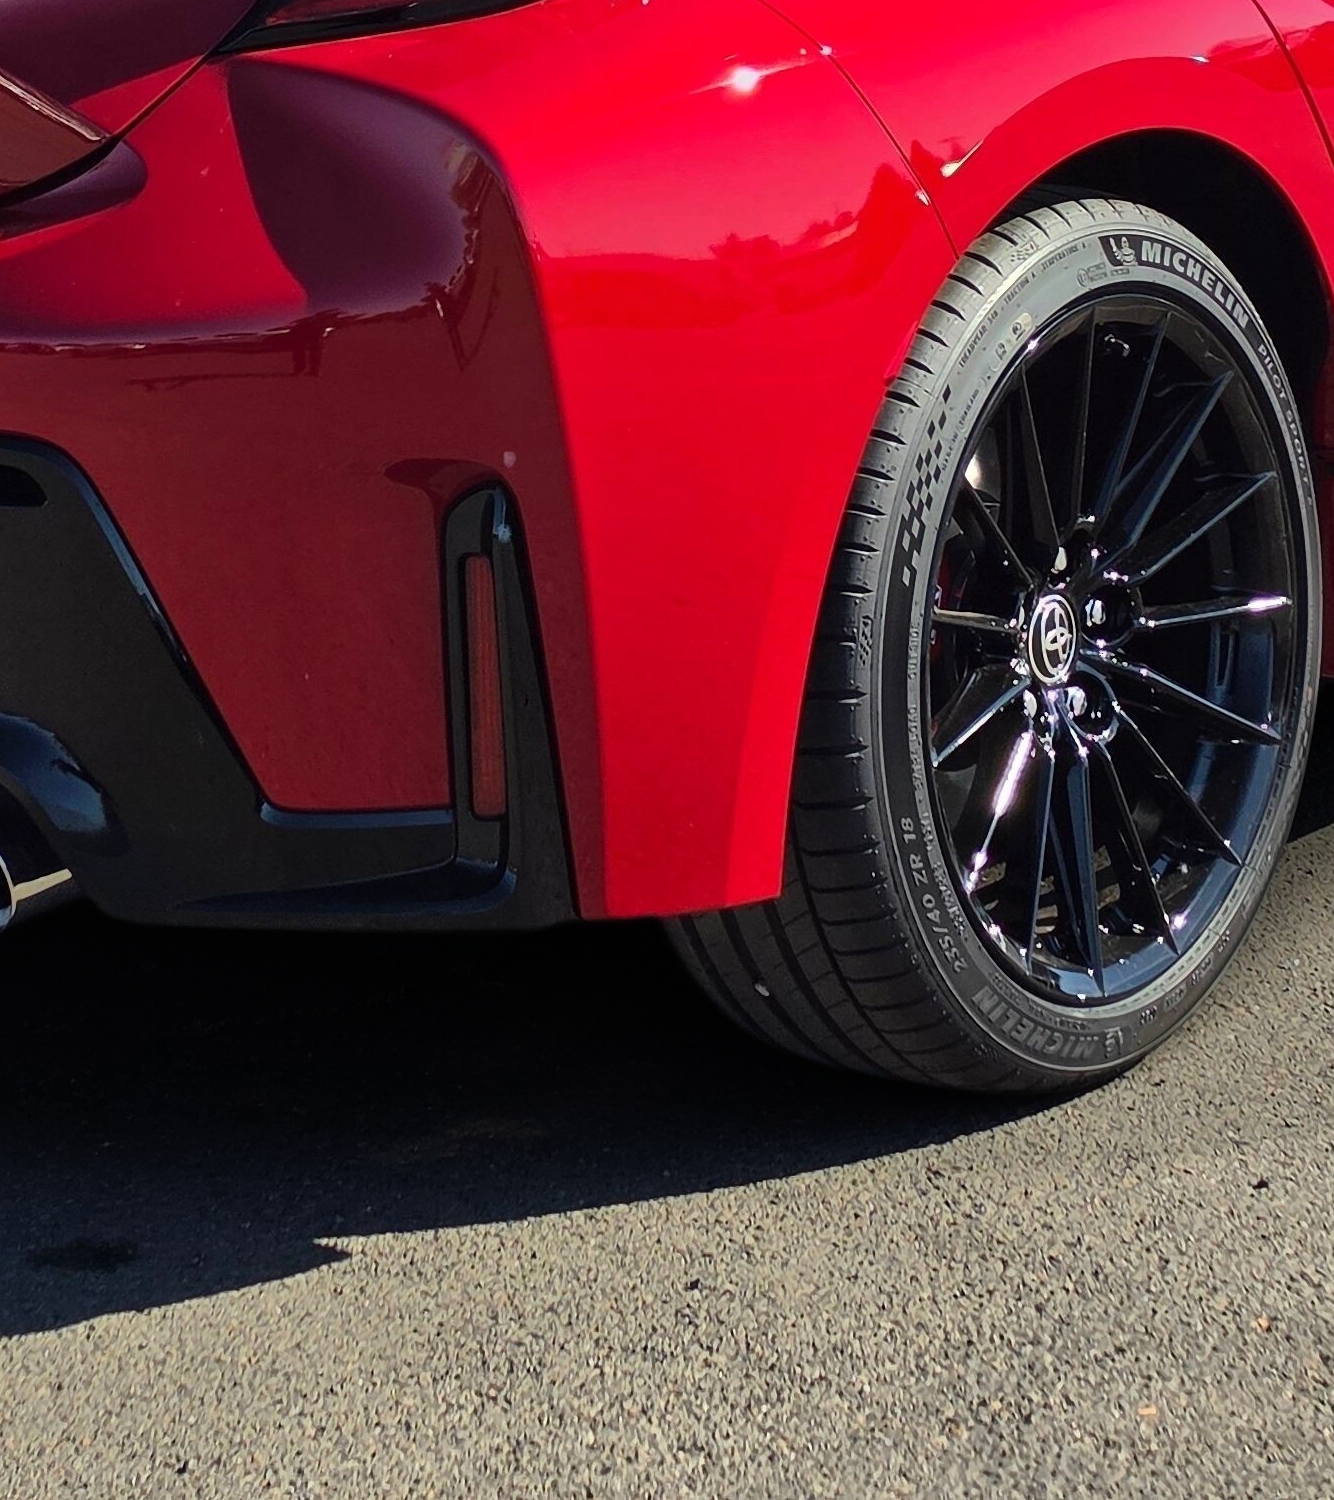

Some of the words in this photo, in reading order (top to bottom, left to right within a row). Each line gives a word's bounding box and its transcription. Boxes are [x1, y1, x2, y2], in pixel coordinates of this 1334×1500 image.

[1003, 279, 1030, 305] TRACTION
[1141, 240, 1250, 329] MICHELIN
[1257, 344, 1286, 399] PILOT
[900, 817, 917, 845] 18
[909, 853, 929, 888] ZR
[922, 893, 969, 974] 235/40
[971, 985, 1099, 1060] MICHELIN
